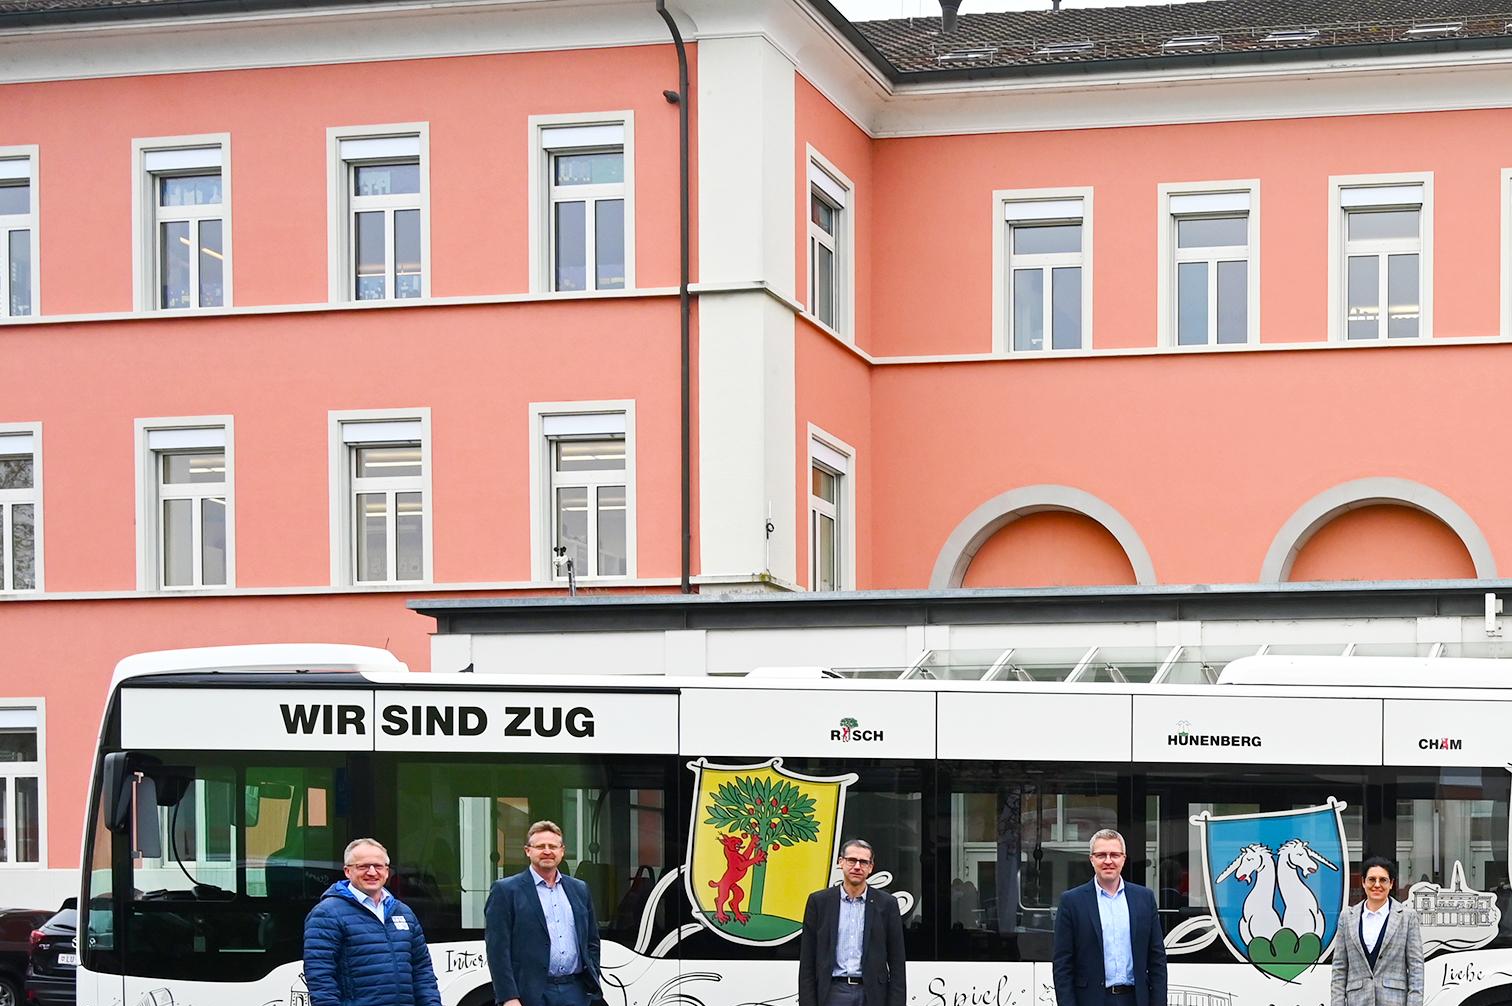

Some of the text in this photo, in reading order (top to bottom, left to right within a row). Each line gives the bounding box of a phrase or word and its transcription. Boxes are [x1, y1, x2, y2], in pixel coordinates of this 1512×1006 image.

[279, 704, 595, 738] WIR SIND ZUG
[1418, 738, 1462, 751] CHAM
[446, 950, 490, 973] Inter
[1442, 962, 1485, 987] Liebe
